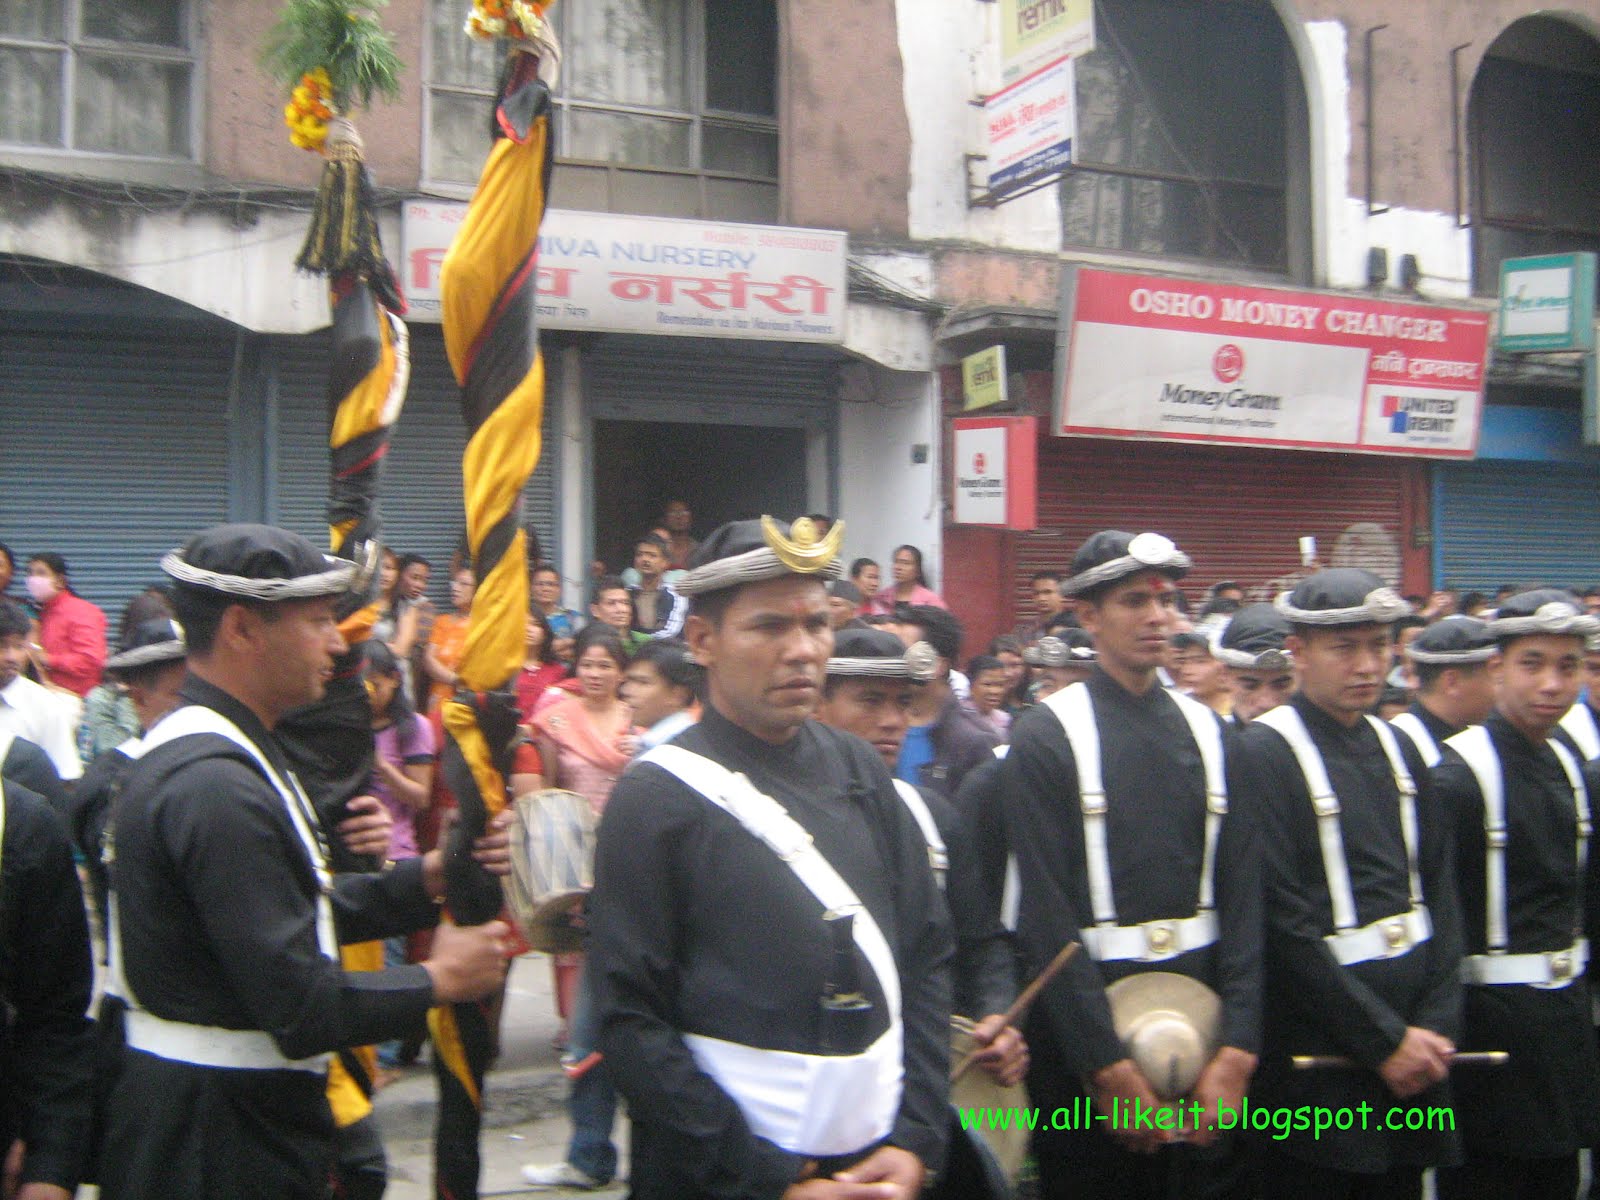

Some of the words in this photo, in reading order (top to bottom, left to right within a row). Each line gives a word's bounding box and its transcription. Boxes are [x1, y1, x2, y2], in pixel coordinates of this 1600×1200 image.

[537, 235, 600, 259] IVA
[611, 240, 757, 270] NURSERY
[608, 271, 835, 317] नर्सरी
[1129, 288, 1214, 319] OSHO
[1220, 298, 1320, 331] MONEY
[1325, 309, 1448, 343] CHANGER
[1159, 383, 1282, 411] MoneyGram
[1400, 397, 1456, 414] UNITED
[1407, 416, 1456, 432] REMIT
